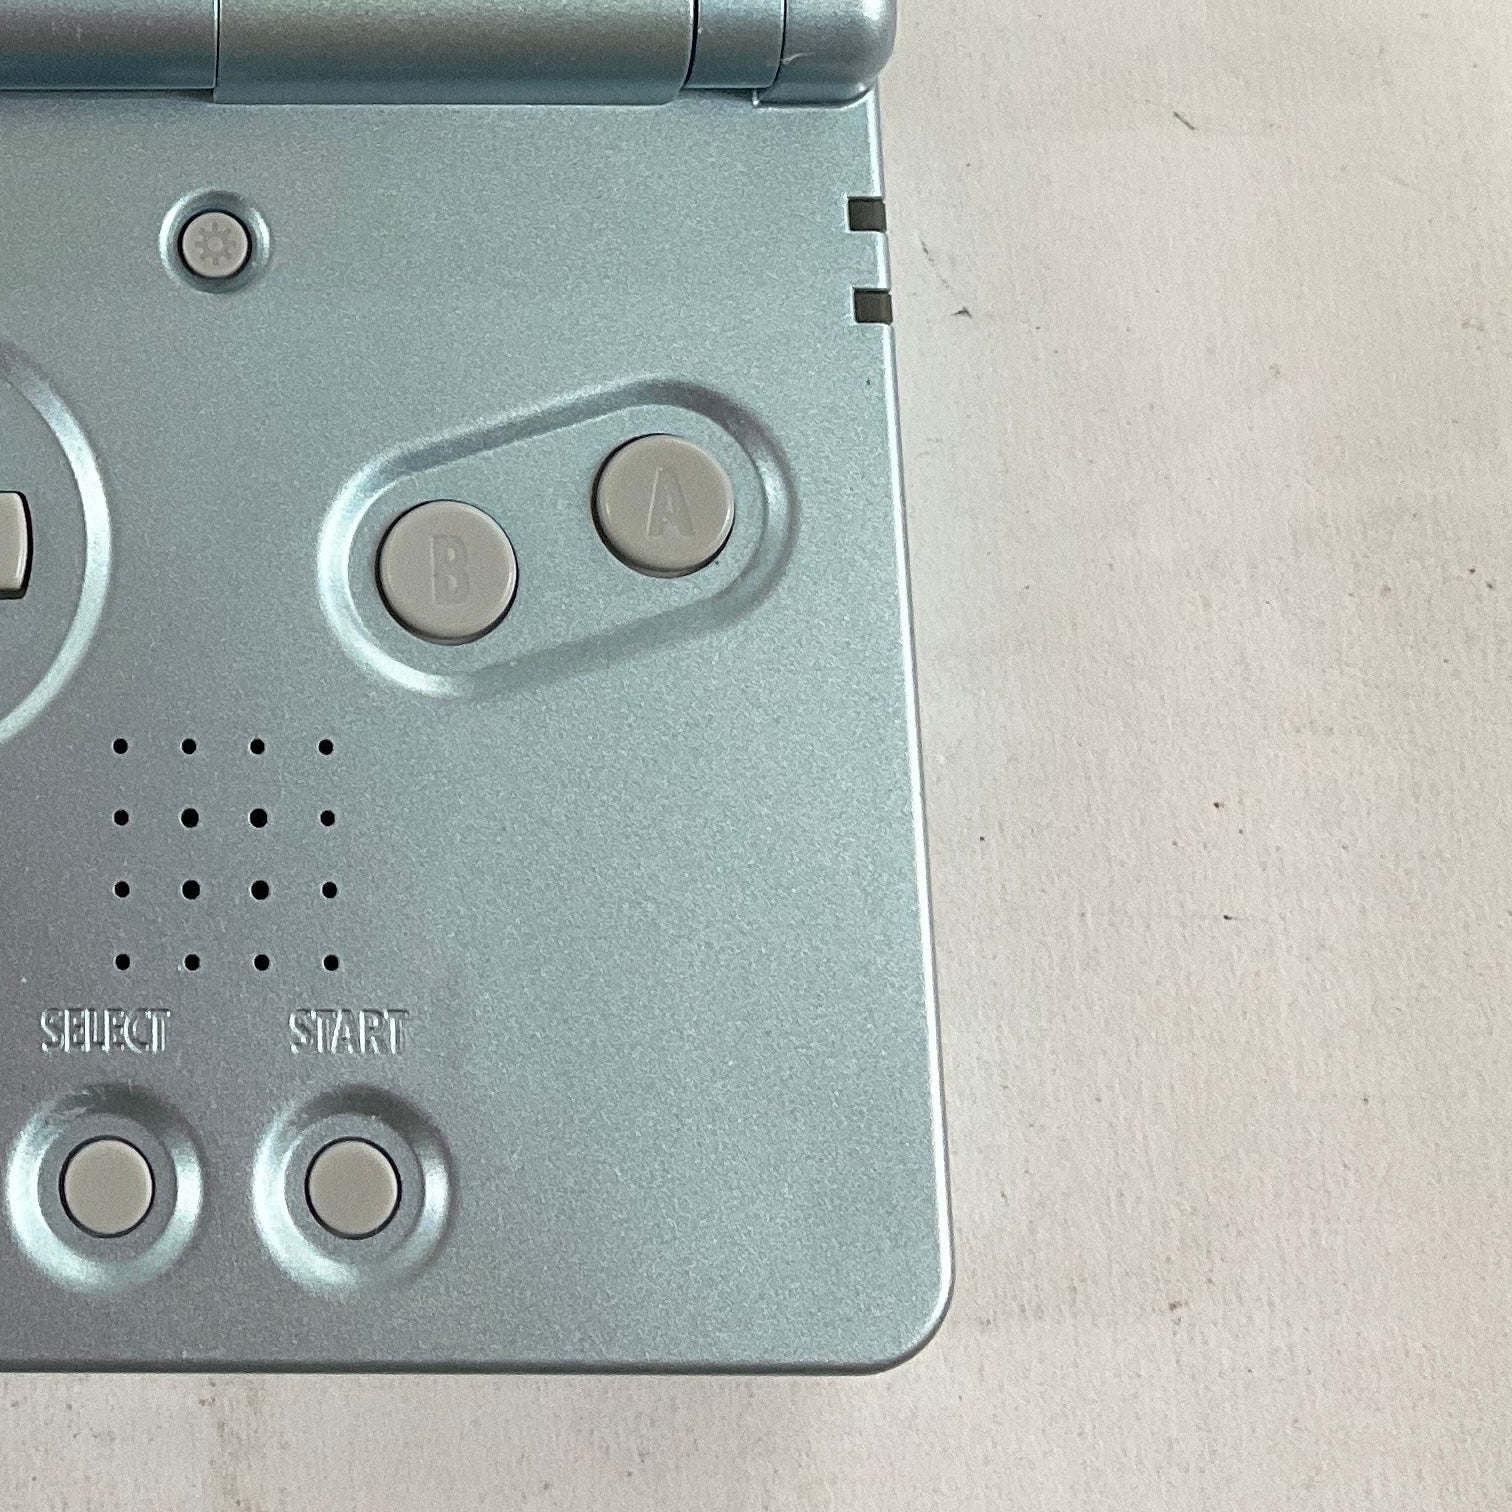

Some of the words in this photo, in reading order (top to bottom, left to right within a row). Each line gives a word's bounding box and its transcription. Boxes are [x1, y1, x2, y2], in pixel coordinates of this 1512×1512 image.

[645, 465, 696, 538] A
[428, 533, 471, 605] B
[40, 1007, 171, 1054] SELECT
[289, 1007, 410, 1055] START
